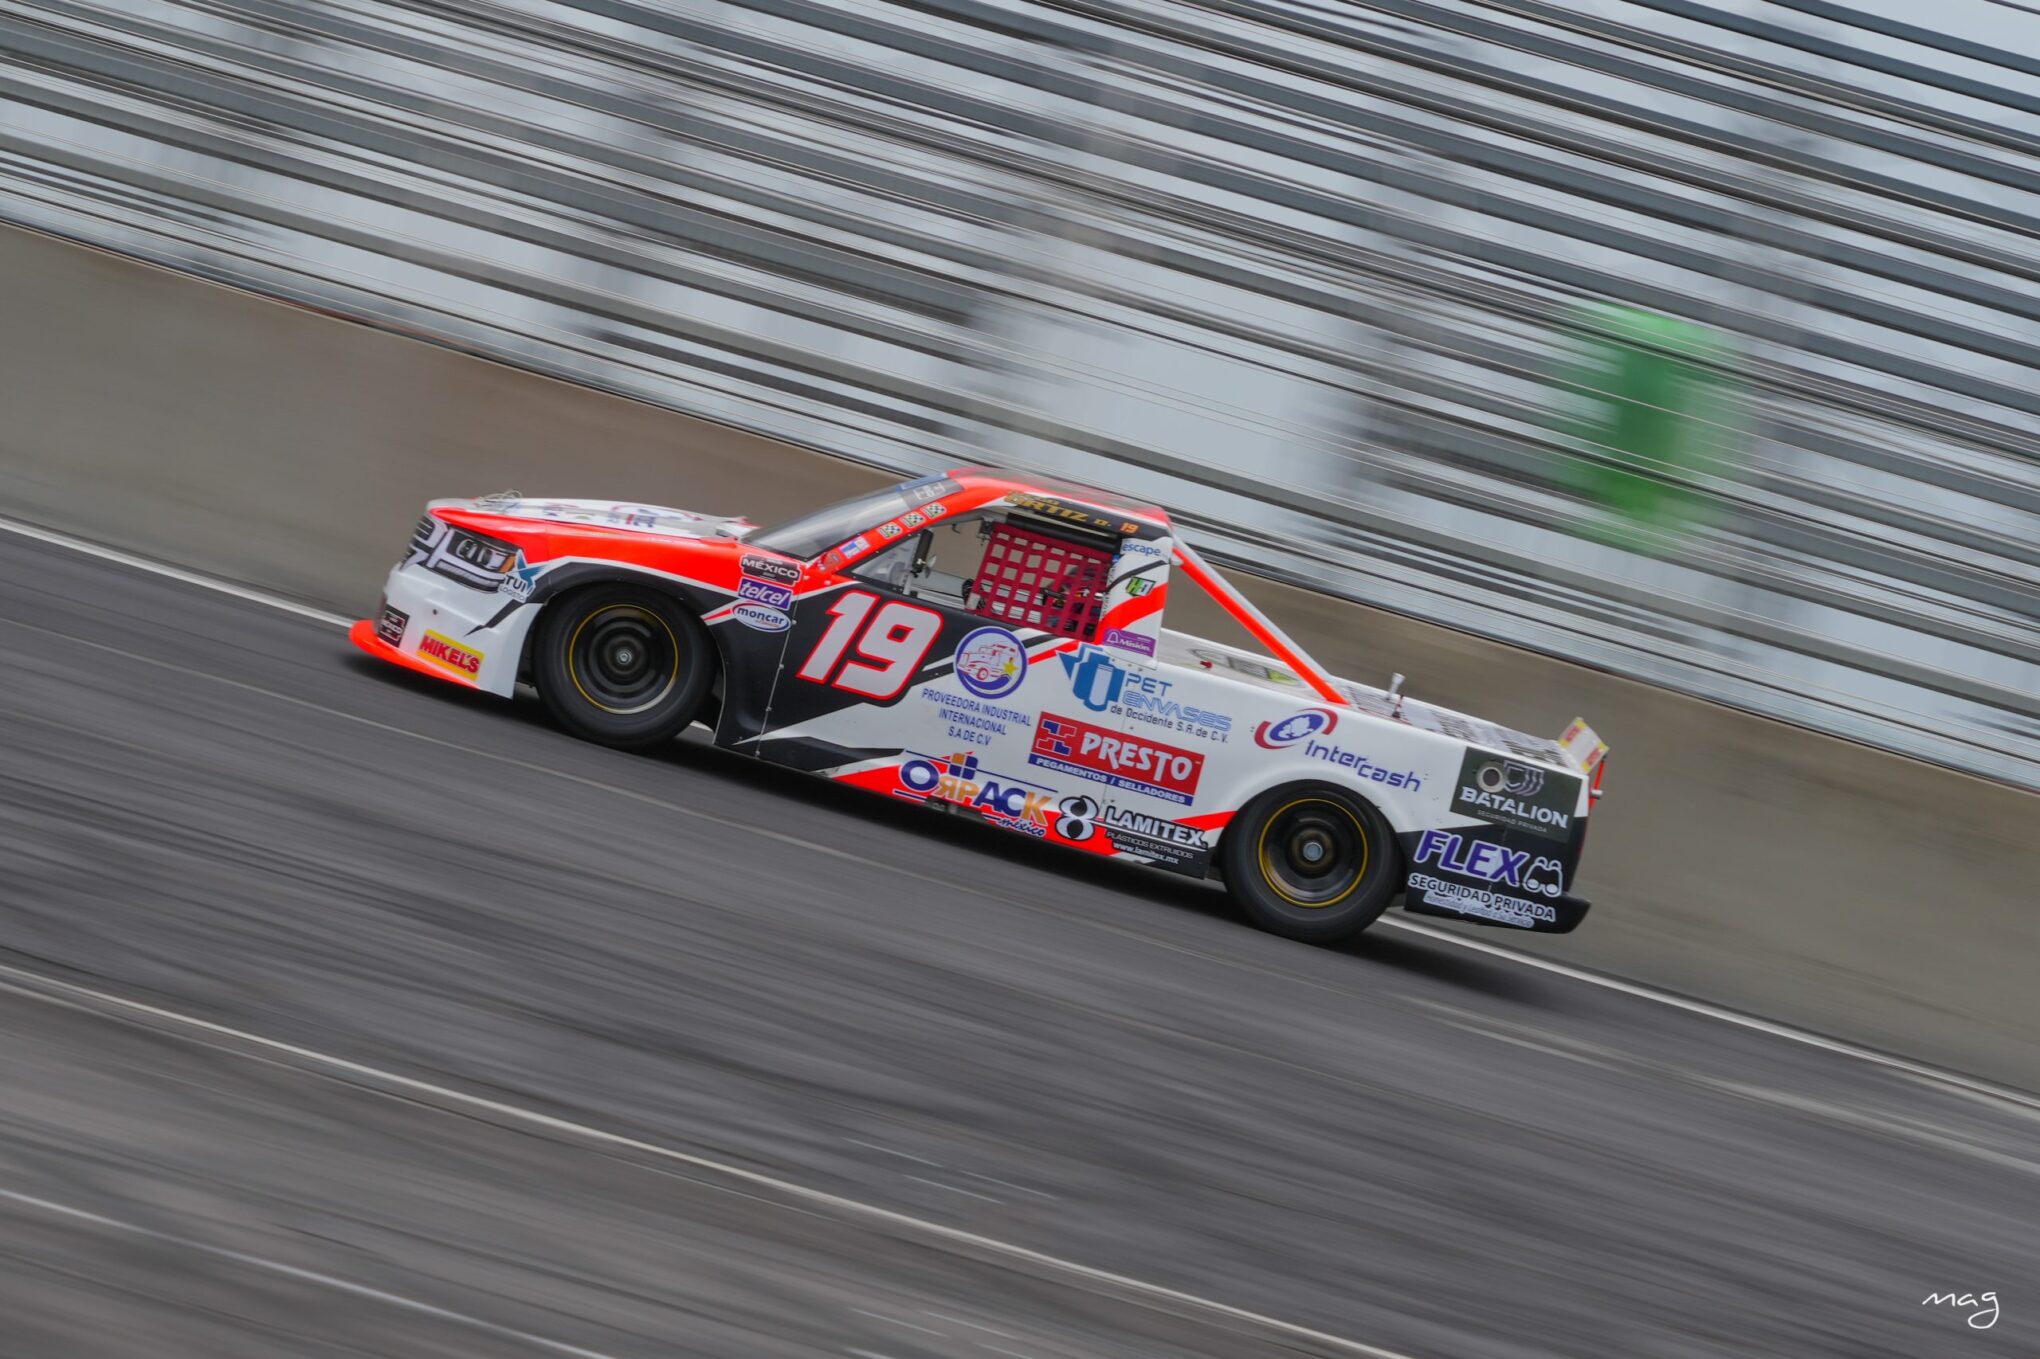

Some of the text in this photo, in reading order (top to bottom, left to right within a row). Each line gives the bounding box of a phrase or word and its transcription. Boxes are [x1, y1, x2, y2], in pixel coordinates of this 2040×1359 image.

[1120, 522, 1139, 534] 19
[1122, 543, 1161, 557] escape
[739, 581, 790, 605] telcel
[737, 607, 785, 625] moncar
[419, 635, 480, 674] MIKEL'S
[795, 589, 944, 700] 19
[1125, 672, 1173, 697] PET
[921, 687, 1031, 727] PROVEEDORA INDUSTRIAL
[938, 708, 1007, 735] INTERNACIONAL
[1110, 704, 1123, 715] de
[1126, 707, 1173, 729] Occidente
[1122, 690, 1232, 732] ENVASES
[963, 729, 976, 742] DE
[1080, 731, 1193, 783] PRESTO
[1304, 739, 1421, 792] Intercash
[1036, 757, 1107, 784] PEGAMENTOS
[1118, 779, 1186, 804] SELLADORES
[1460, 786, 1569, 829] BATALION
[1477, 809, 1548, 833] SEGURIDAD PRIVADA
[1150, 842, 1194, 859] EXTRUIDOS
[1414, 829, 1530, 887] FLEX
[1408, 873, 1492, 906] SEGURIDAD
[1494, 894, 1556, 922] PRIVADA
